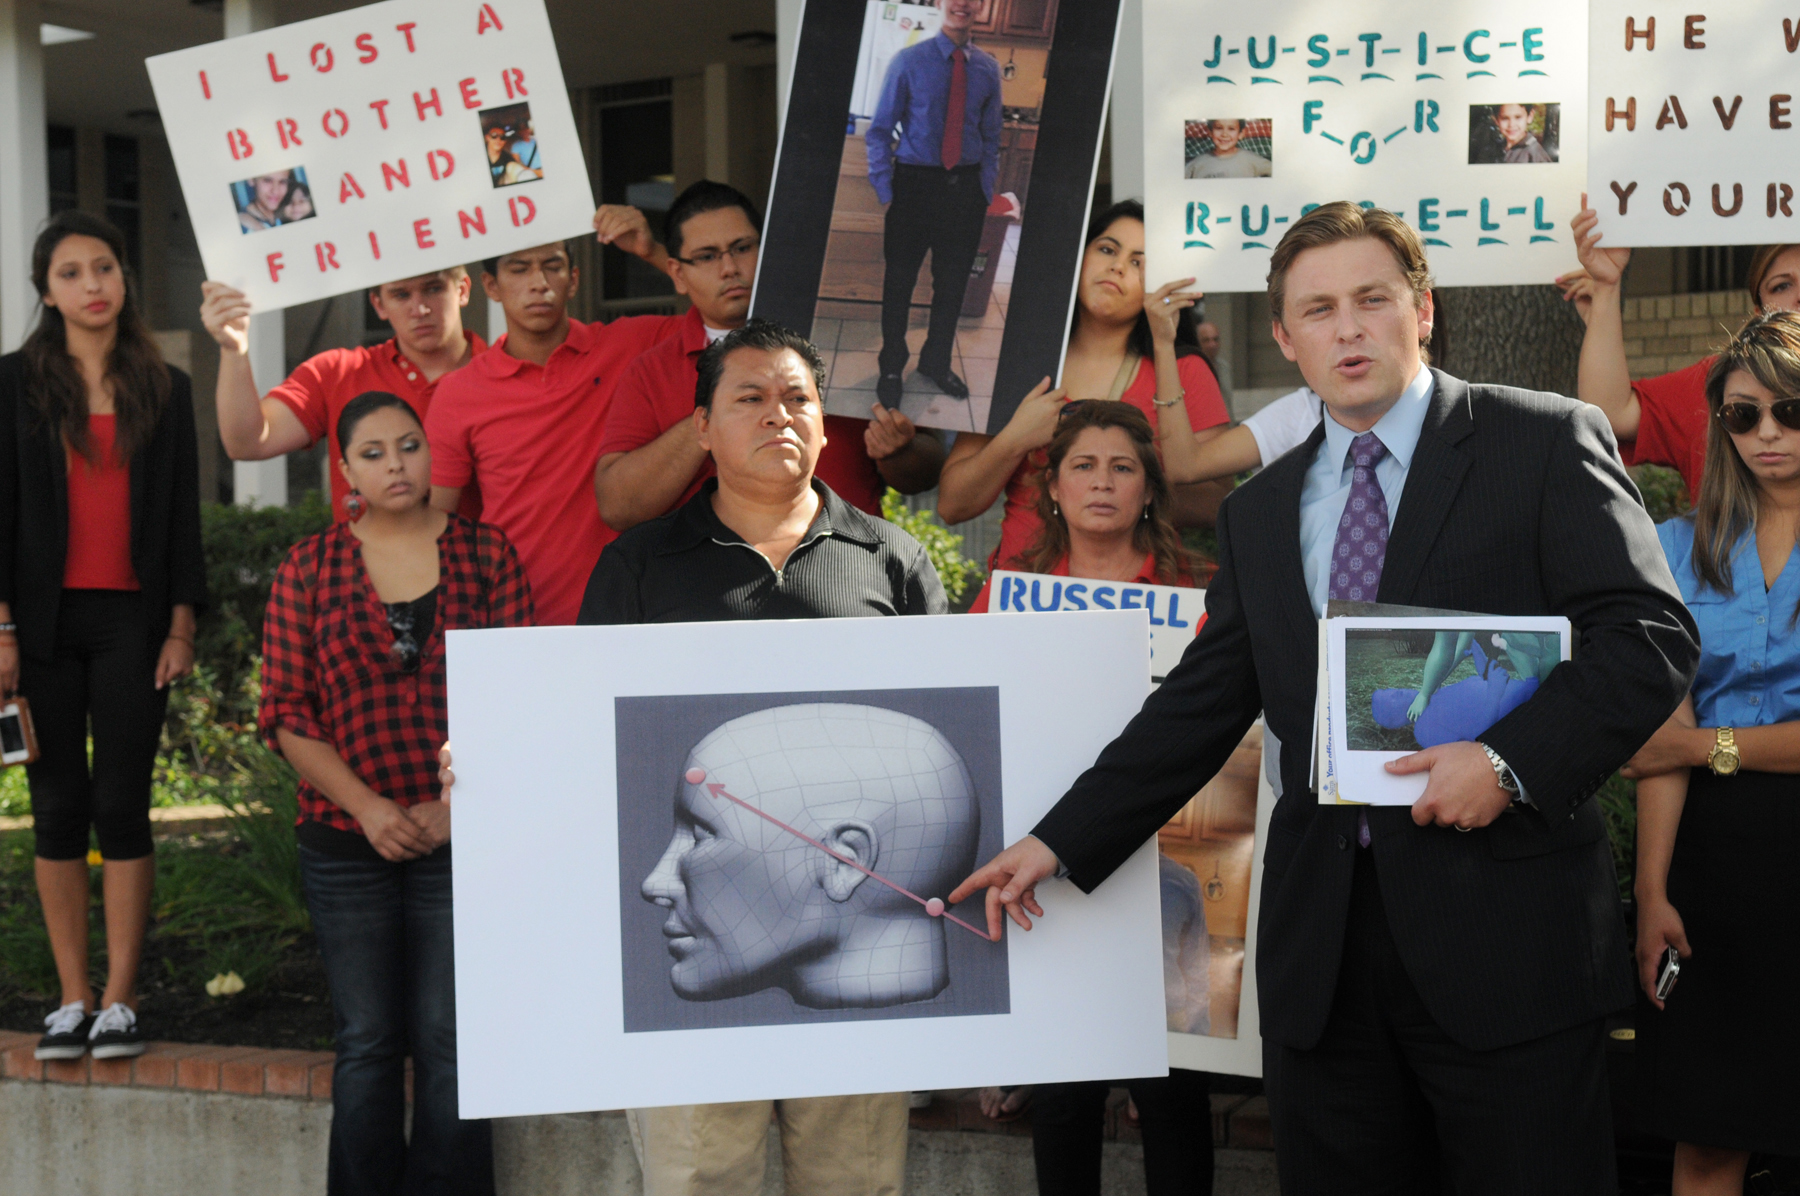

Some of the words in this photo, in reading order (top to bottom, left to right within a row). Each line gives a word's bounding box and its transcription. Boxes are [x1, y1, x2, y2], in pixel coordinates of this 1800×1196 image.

[198, 70, 212, 100] I
[266, 21, 417, 83] LOST
[477, 3, 504, 35] A
[1624, 14, 1707, 52] HE
[226, 67, 529, 161] BROTHER
[1605, 94, 1792, 132] HAVE
[339, 149, 455, 204] AND
[1610, 181, 1794, 218] YOUR
[266, 195, 537, 283] FRIEND
[999, 576, 1189, 628] RUSSELL
